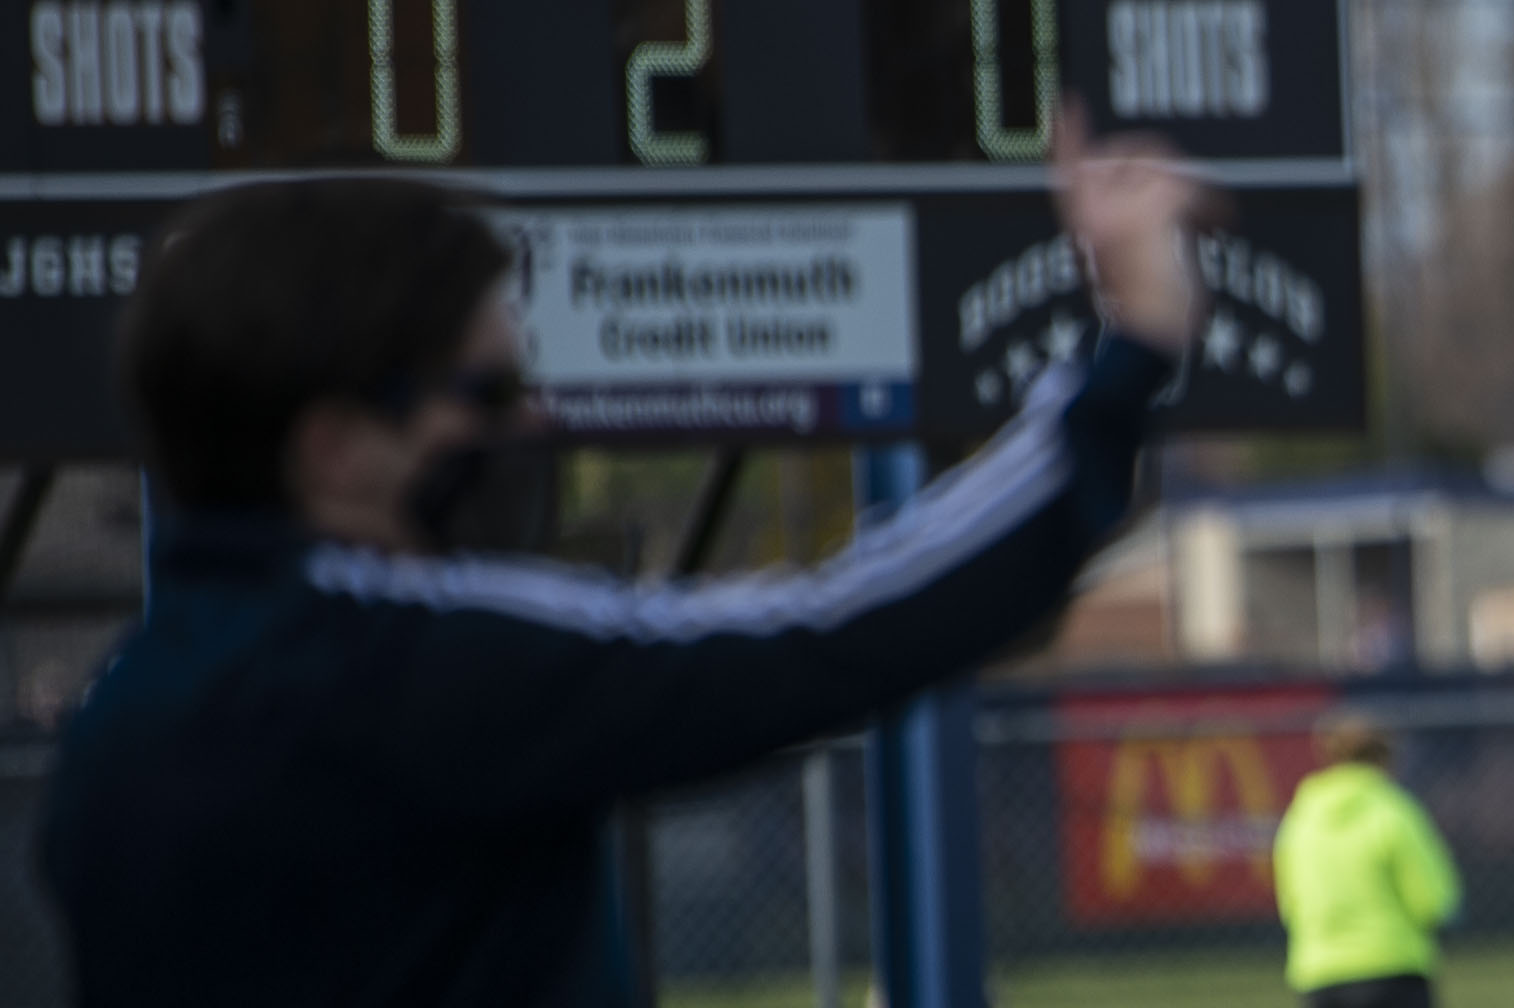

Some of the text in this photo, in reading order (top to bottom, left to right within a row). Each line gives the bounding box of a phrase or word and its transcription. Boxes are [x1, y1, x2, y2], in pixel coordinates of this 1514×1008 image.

[31, 2, 206, 125] SHOTS
[1108, 1, 1271, 118] SHOTS
[569, 252, 856, 307] Frankenmuth
[600, 314, 834, 360] Credit Union
